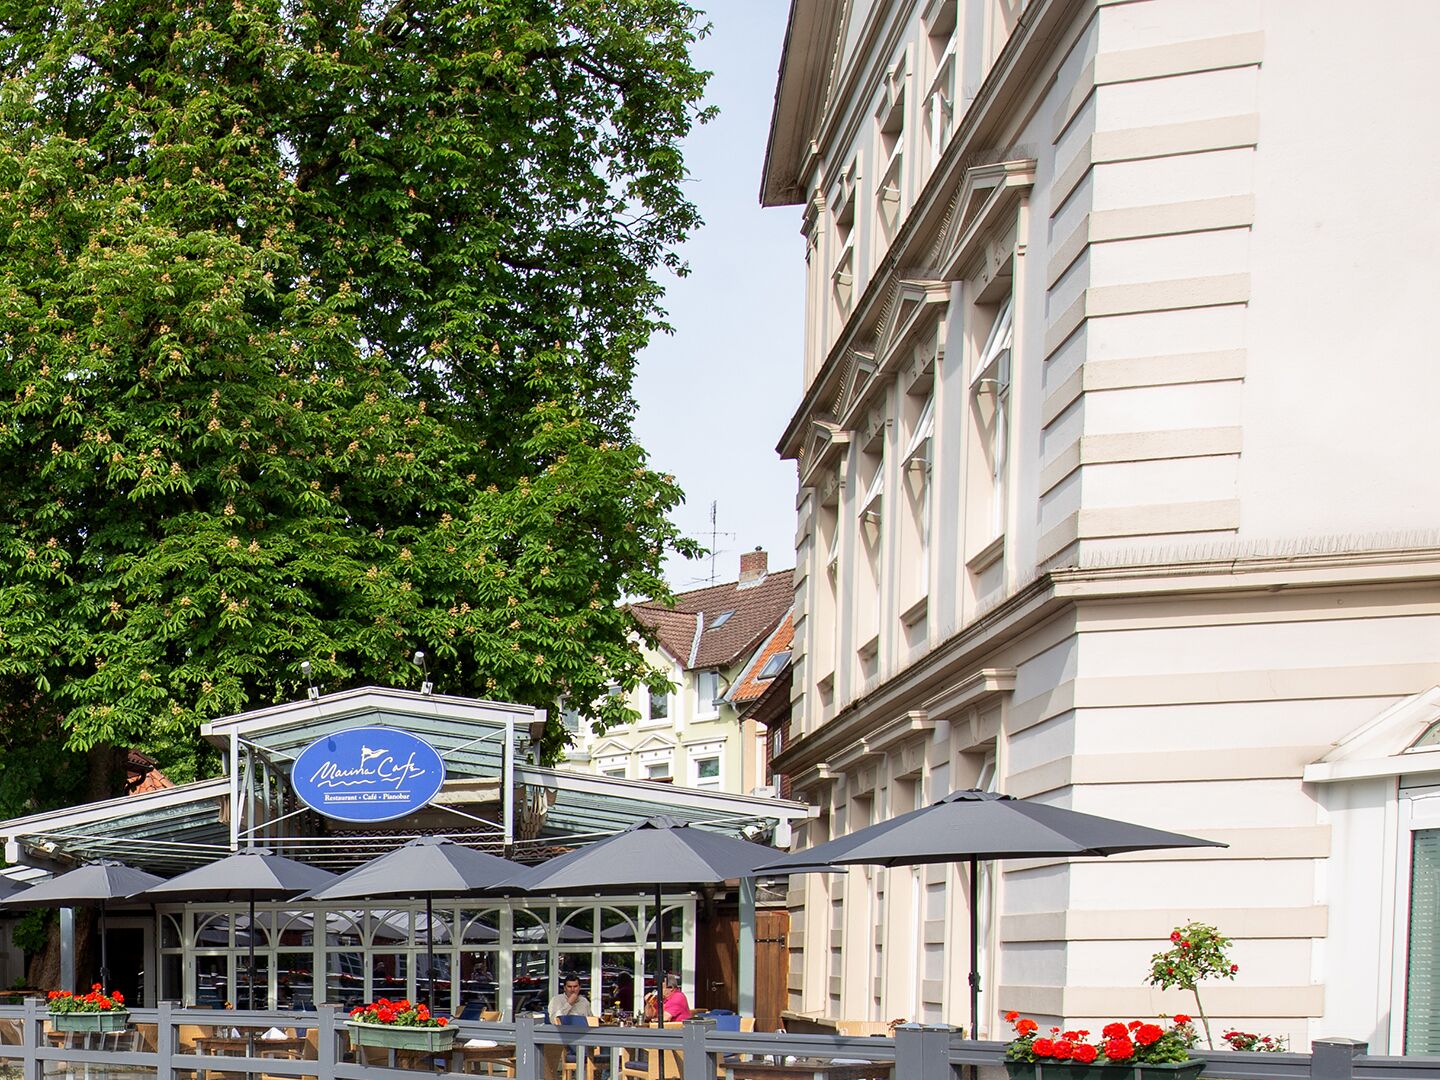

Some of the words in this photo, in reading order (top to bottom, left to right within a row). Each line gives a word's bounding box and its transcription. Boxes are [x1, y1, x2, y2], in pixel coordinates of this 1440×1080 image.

[310, 761, 376, 783] Marina
[324, 794, 358, 802] Restaurant
[362, 793, 377, 801] Café
[383, 792, 410, 800] Pianobar
